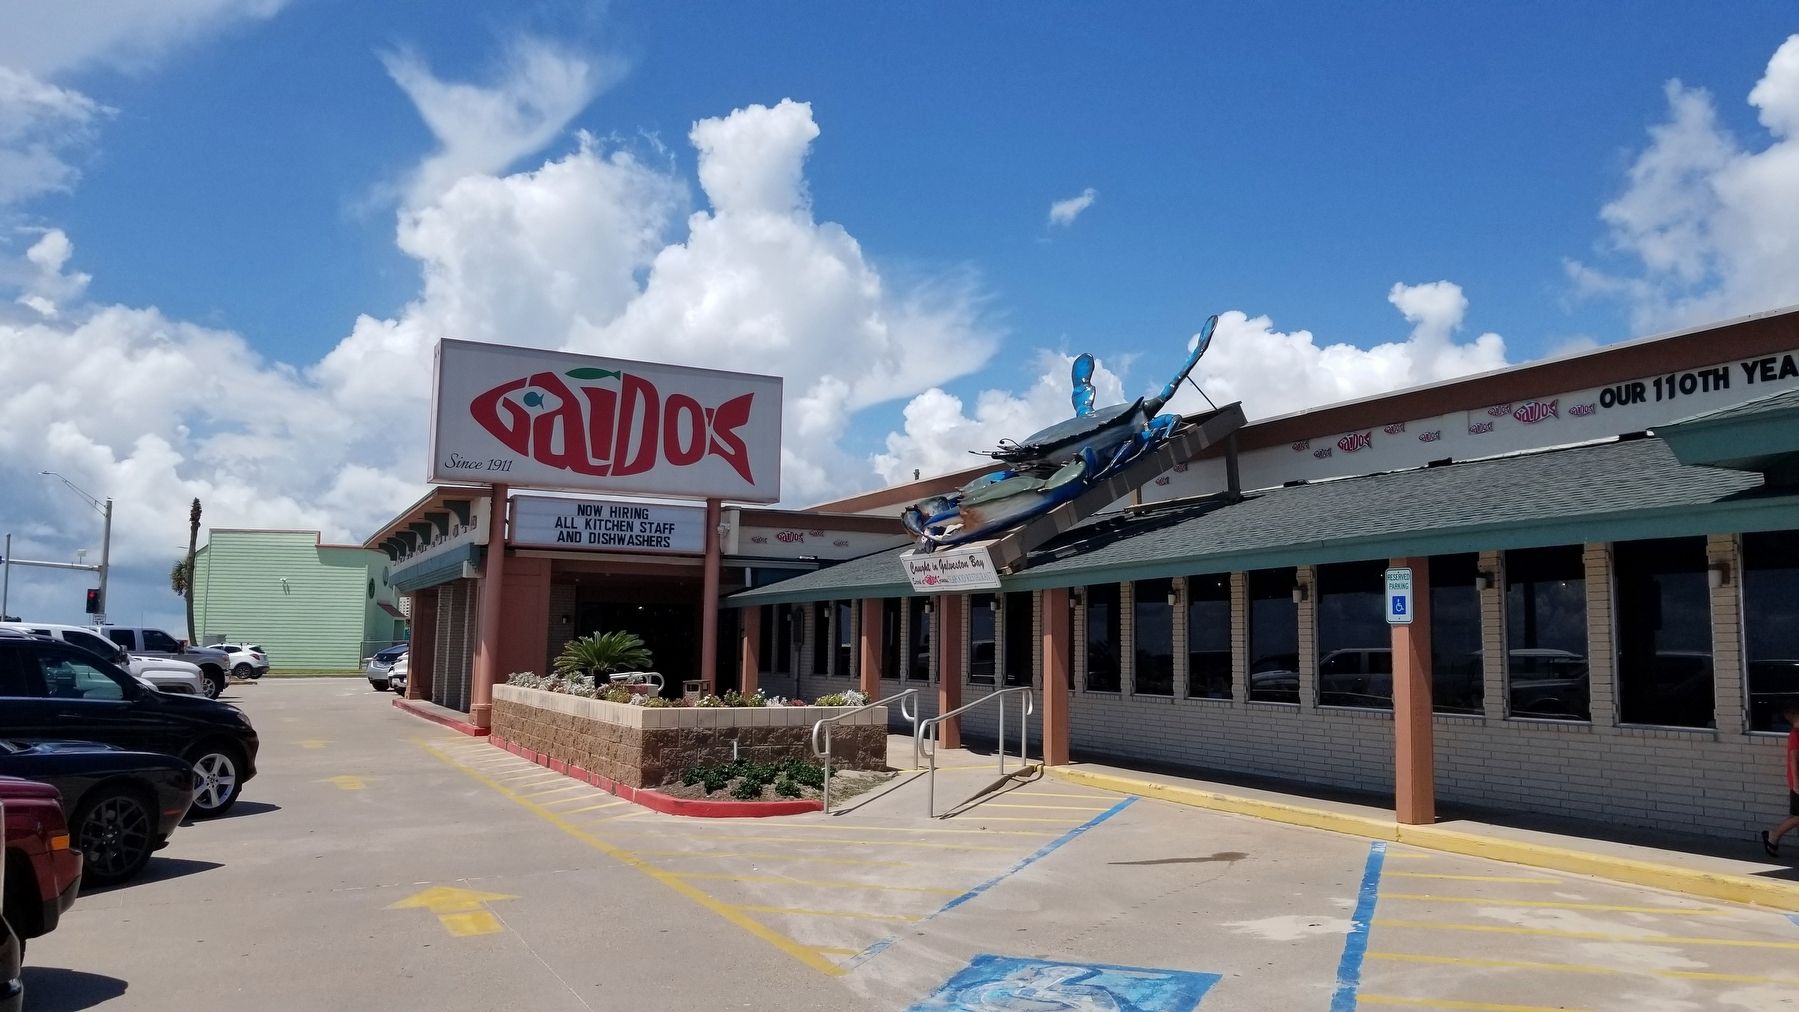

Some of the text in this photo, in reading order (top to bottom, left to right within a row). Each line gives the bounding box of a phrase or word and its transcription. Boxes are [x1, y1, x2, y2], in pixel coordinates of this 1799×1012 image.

[1599, 354, 1799, 409] OUR 110TH YEA
[444, 452, 513, 472] Since 1911
[577, 504, 649, 520] NOW HIRING
[555, 516, 675, 535] ALL KITCHEN STAFF
[557, 530, 670, 548] AND DISHWASHERS
[910, 555, 985, 575] Caught in Galveston Bay
[1389, 582, 1409, 590] PARKING
